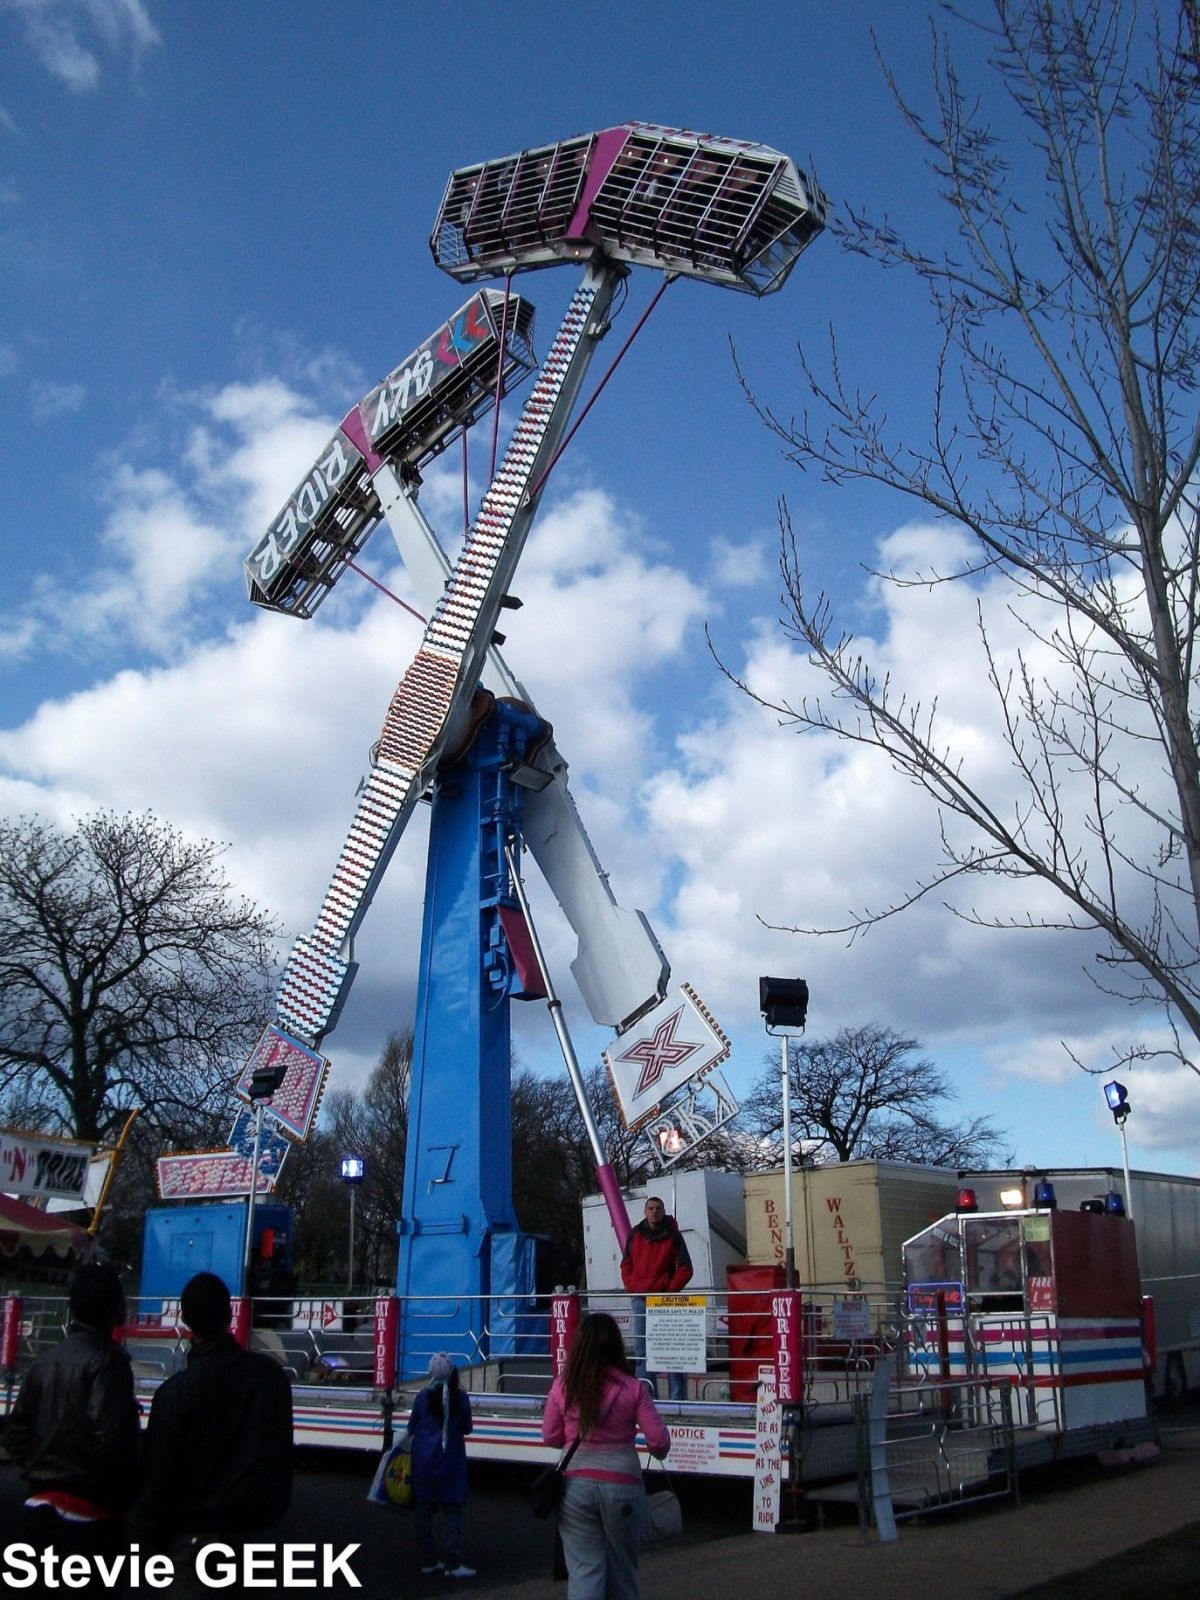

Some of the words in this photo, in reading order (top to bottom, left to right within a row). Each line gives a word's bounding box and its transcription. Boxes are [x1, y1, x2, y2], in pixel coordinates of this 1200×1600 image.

[370, 349, 434, 436] SKY
[254, 439, 348, 581] RIDER
[33, 1148, 89, 1195] PRIZE
[375, 1301, 389, 1317] SKY
[553, 1300, 570, 1318] SKY
[772, 1298, 793, 1318] SKY
[376, 1318, 387, 1384] RIDER
[556, 1319, 568, 1376] RIDE
[776, 1318, 792, 1399] RIDER
[671, 1428, 705, 1439] NOTICE
[758, 1421, 767, 1432] BE
[769, 1422, 778, 1434] AS
[760, 1438, 777, 1454] TALL
[756, 1458, 764, 1469] AS
[768, 1459, 780, 1470] THE
[762, 1497, 771, 1508] TO
[758, 1511, 774, 1524] RIDE
